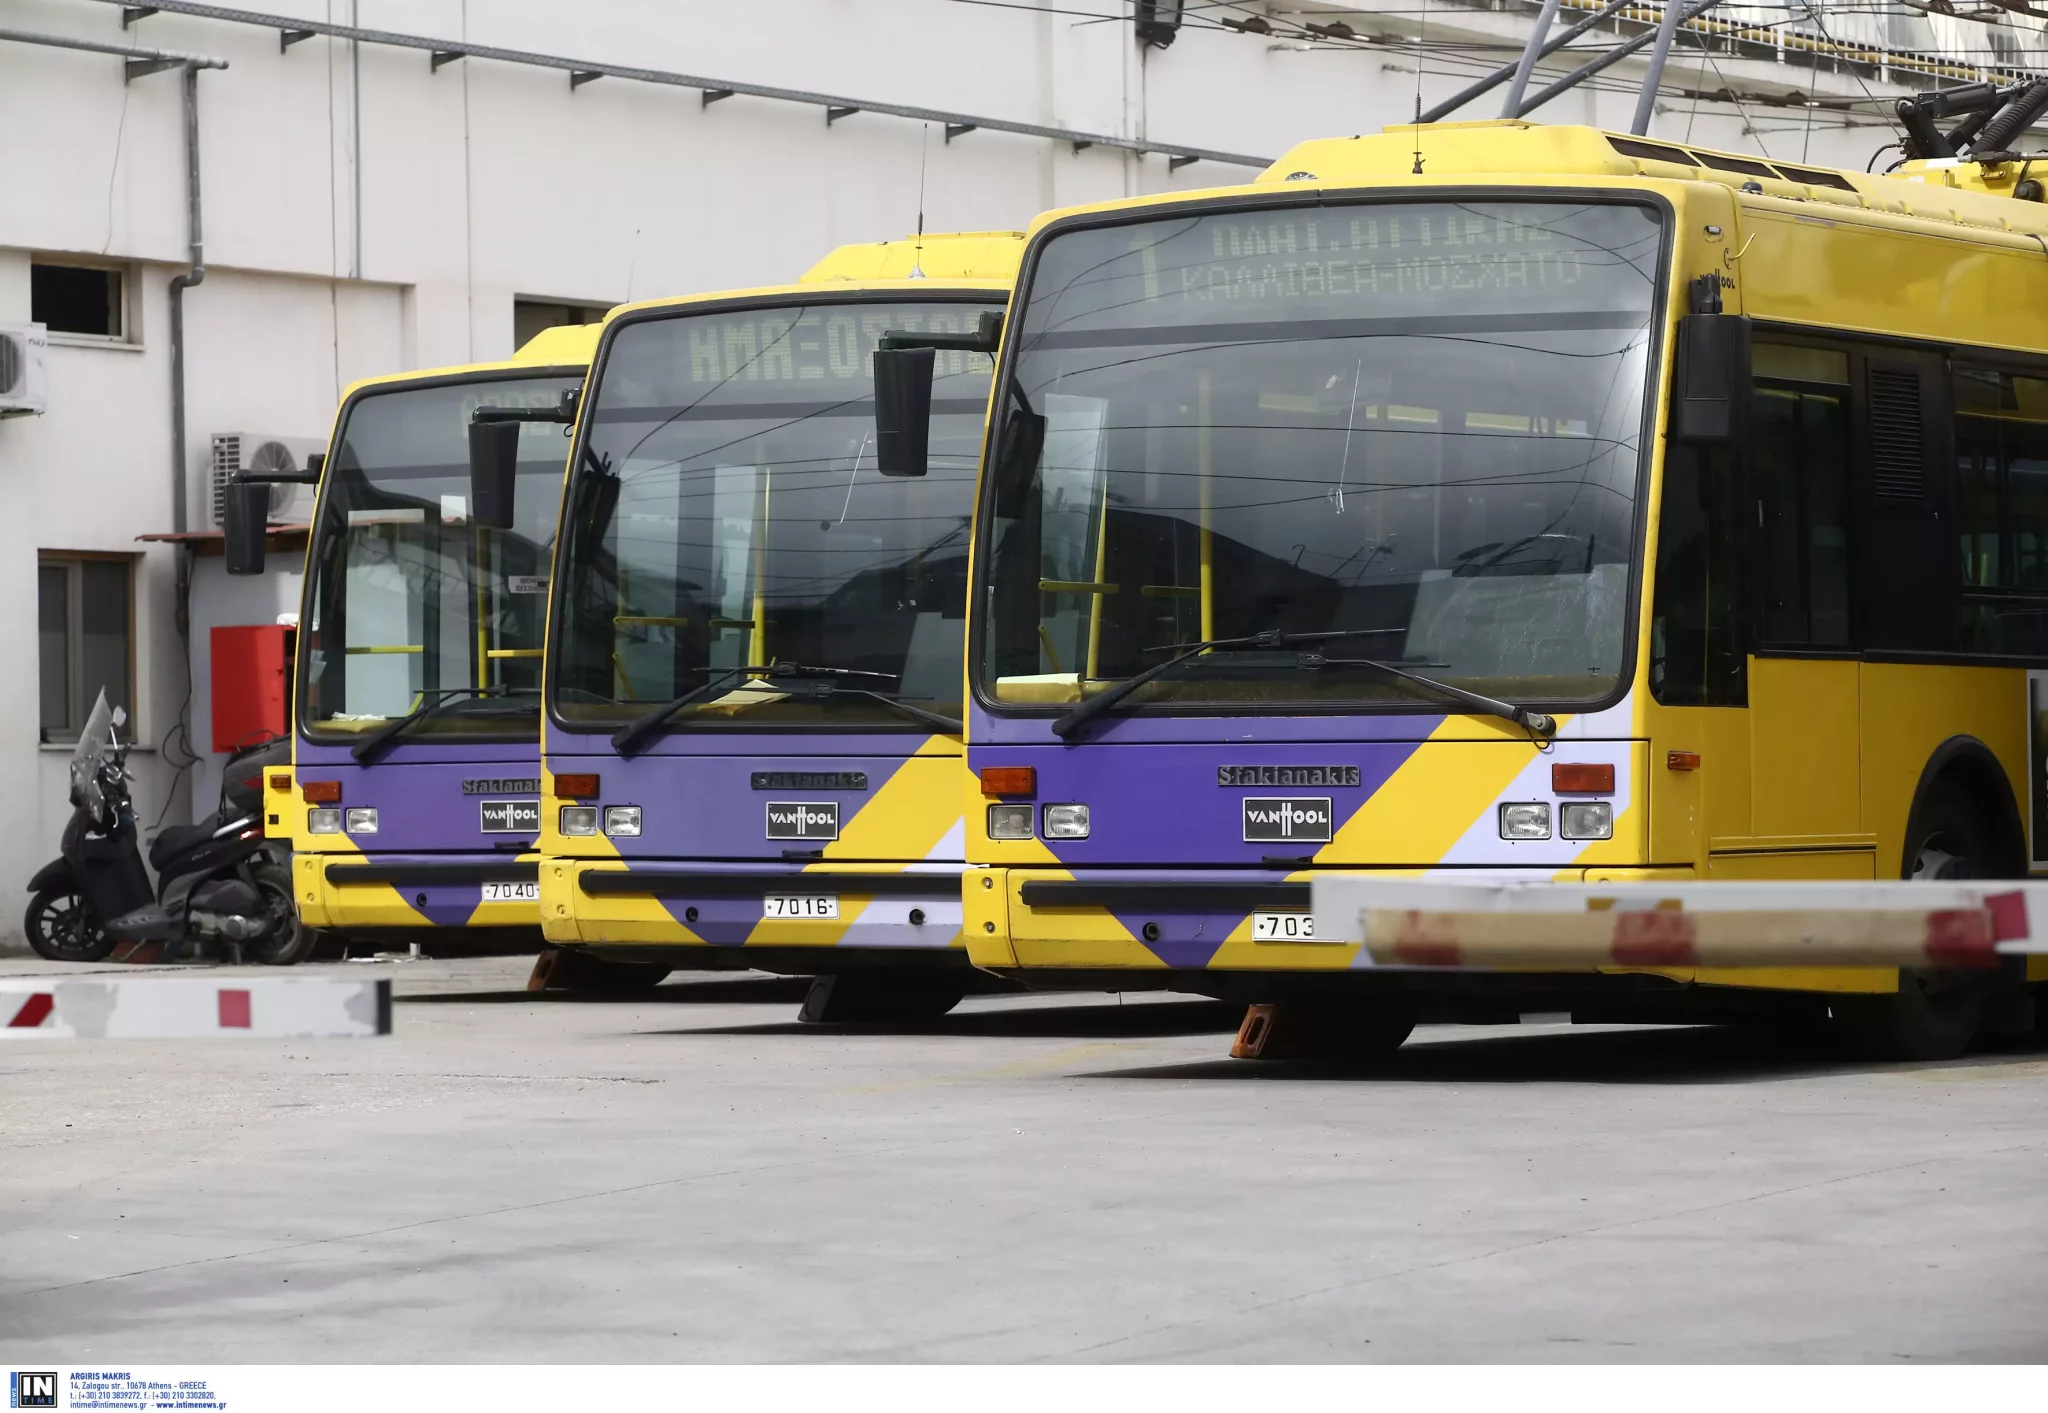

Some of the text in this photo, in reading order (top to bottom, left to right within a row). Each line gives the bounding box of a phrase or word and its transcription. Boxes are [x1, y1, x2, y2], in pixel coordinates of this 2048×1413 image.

[1129, 229, 1159, 302] 1
[1218, 765, 1359, 786] Sfakianakis
[489, 883, 534, 897] 7040
[774, 898, 827, 915] 7016
